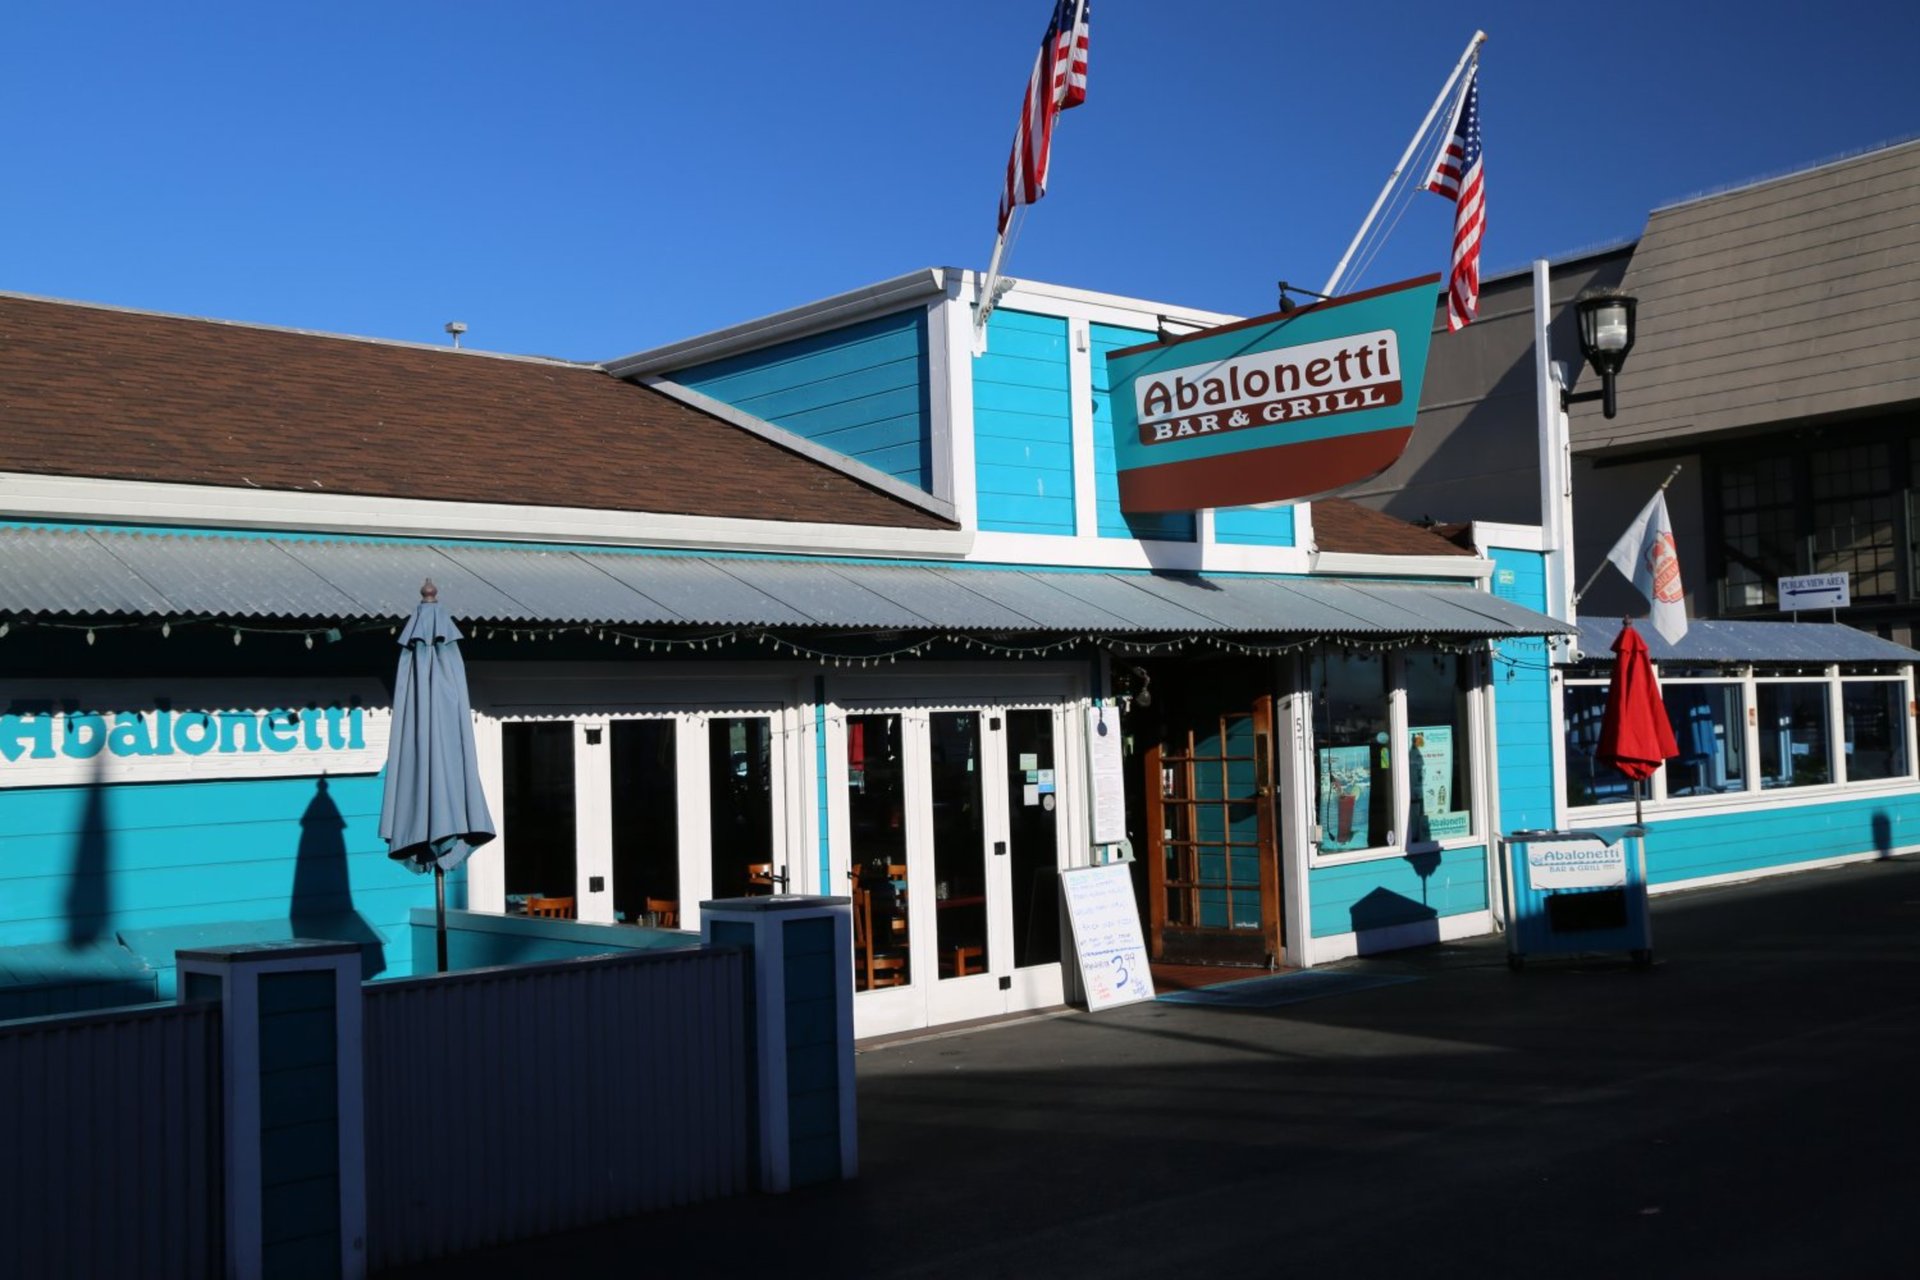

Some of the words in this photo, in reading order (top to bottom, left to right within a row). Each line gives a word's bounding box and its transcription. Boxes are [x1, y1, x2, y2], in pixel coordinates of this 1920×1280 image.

[1143, 339, 1391, 416] Abalonetti
[1154, 415, 1220, 441] BAR
[1228, 409, 1251, 428] &
[1262, 387, 1386, 423] GRILL
[1781, 580, 1805, 590] PUBLIC
[1806, 578, 1824, 587] VIEW
[1826, 576, 1845, 586] AREA
[1544, 848, 1620, 861] Abalonetti
[1549, 865, 1567, 873] BAR
[1577, 863, 1601, 871] GRILL
